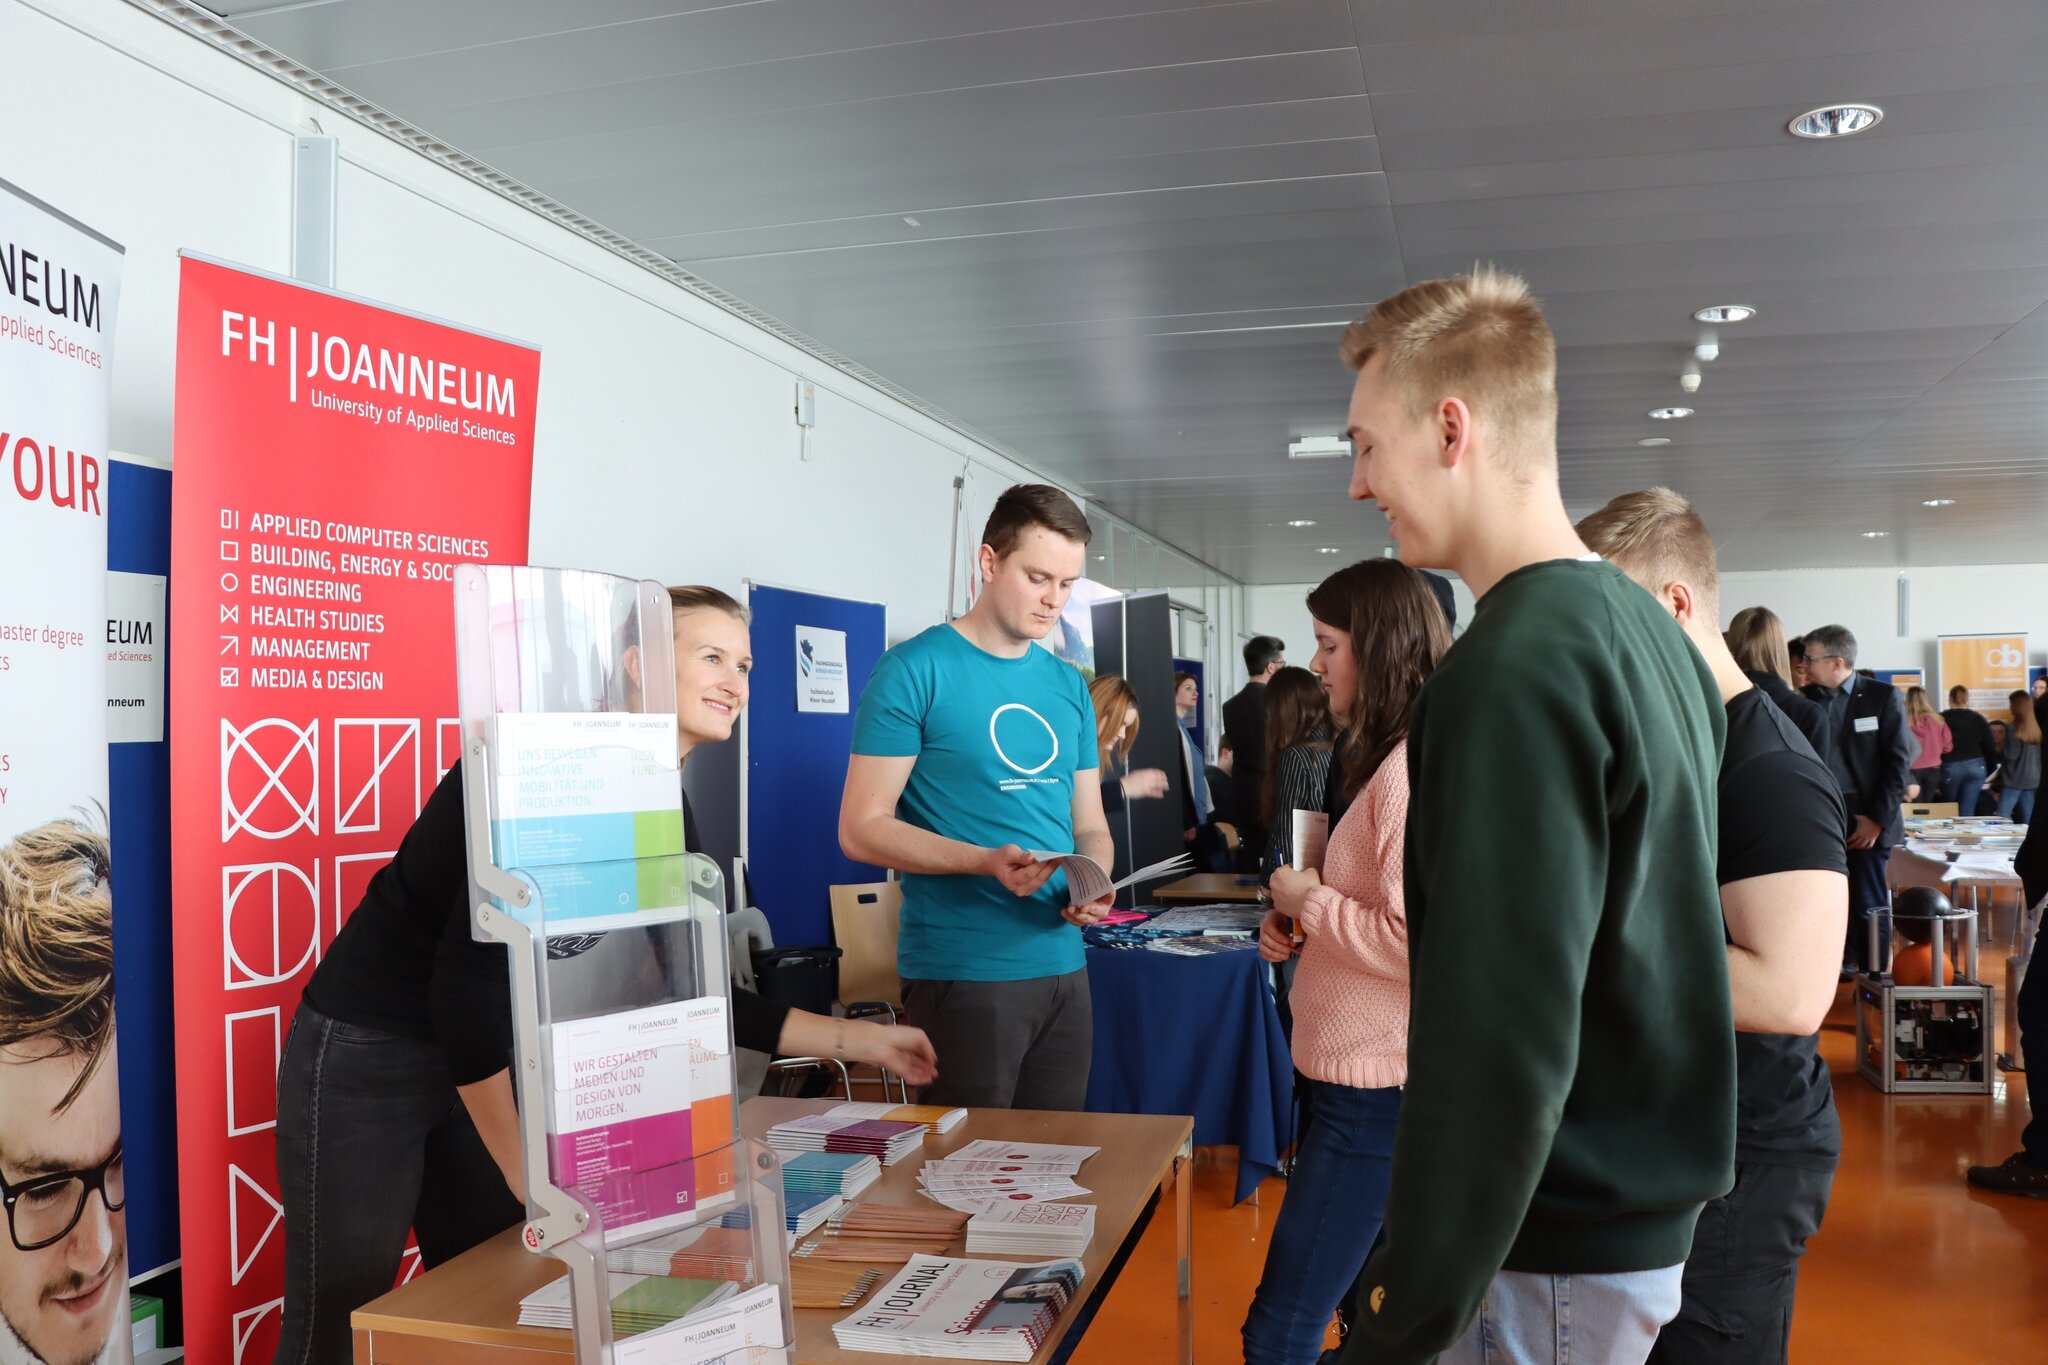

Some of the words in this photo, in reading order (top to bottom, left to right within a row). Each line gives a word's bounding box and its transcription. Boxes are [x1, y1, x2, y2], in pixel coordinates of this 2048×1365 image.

[48, 330, 102, 369] Sciences
[222, 309, 275, 366] FH
[307, 331, 516, 418] JOANNEUM
[311, 388, 383, 424] University
[387, 406, 402, 424] of
[406, 409, 459, 434] Applied
[462, 420, 516, 446] Sciences
[250, 512, 321, 539] APPLIED
[326, 522, 413, 550] COMPUTER
[417, 533, 489, 558] SCIENCES
[251, 543, 336, 574] BUILDING,
[341, 554, 403, 576] ENERGY
[407, 561, 418, 579] &
[422, 562, 456, 581] SOC
[251, 574, 362, 602] ENGINEERING
[251, 605, 315, 629] HEALTH
[319, 610, 385, 633] STUDIES
[42, 624, 84, 649] degree
[107, 619, 153, 645] EUM
[119, 651, 153, 662] Sciences
[251, 637, 371, 661] MANAGEMENT
[251, 668, 308, 688] MEDIA
[312, 671, 323, 689] &
[327, 671, 384, 690] DESIGN
[107, 697, 145, 707] nneum
[517, 748, 541, 761] UNS
[517, 763, 584, 777] INNOVATIVE
[580, 778, 604, 791] UND
[628, 1023, 638, 1032] FH
[641, 1017, 678, 1030] JOANNEUM
[573, 1059, 596, 1073] WIR
[598, 1048, 658, 1069] GESTALTEN
[574, 1072, 618, 1089] MEDIEN
[620, 1066, 645, 1081] UND
[575, 1090, 616, 1107] DESIGN
[617, 1083, 641, 1097] VON
[575, 1103, 627, 1122] MORGEN.
[856, 1305, 896, 1329] FH
[885, 1263, 950, 1312] JOURNAL
[684, 1333, 694, 1344] FH
[698, 1322, 737, 1341] JOANNEUM
